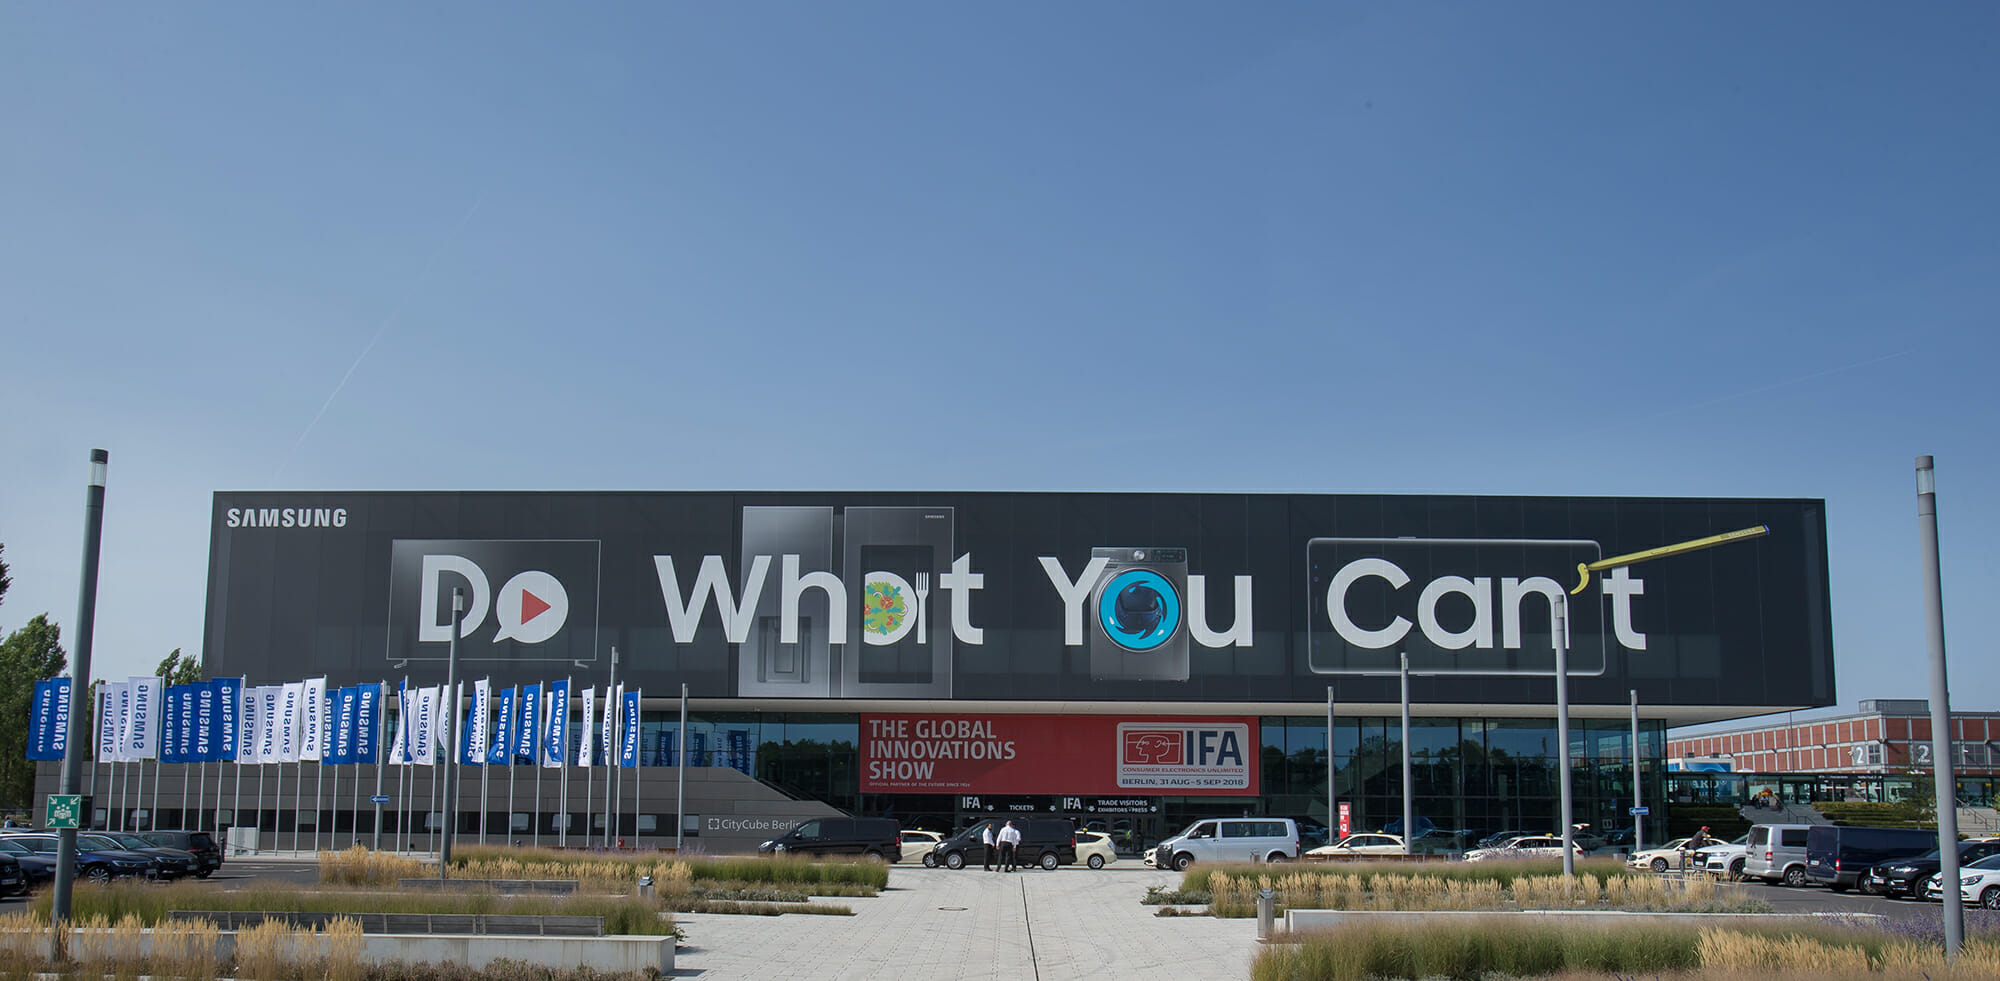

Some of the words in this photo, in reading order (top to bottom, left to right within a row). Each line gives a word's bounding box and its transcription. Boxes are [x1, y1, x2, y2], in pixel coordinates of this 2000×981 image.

[227, 508, 347, 528] SAMSUNG
[419, 554, 569, 643] Do
[1037, 557, 1253, 648] You
[1327, 558, 1647, 650] Can't
[869, 719, 908, 738] THE
[915, 720, 997, 739] GLOBAL
[870, 740, 1016, 760] INNOVATIONS
[1186, 730, 1243, 766] IFA
[1855, 747, 1865, 764] 2
[1918, 745, 1930, 763] 2
[869, 761, 934, 780] SHOW
[1122, 778, 1158, 786] BERLIN,
[962, 796, 981, 809] IFA
[1063, 797, 1082, 810] IFA
[721, 819, 769, 831] CityCube
